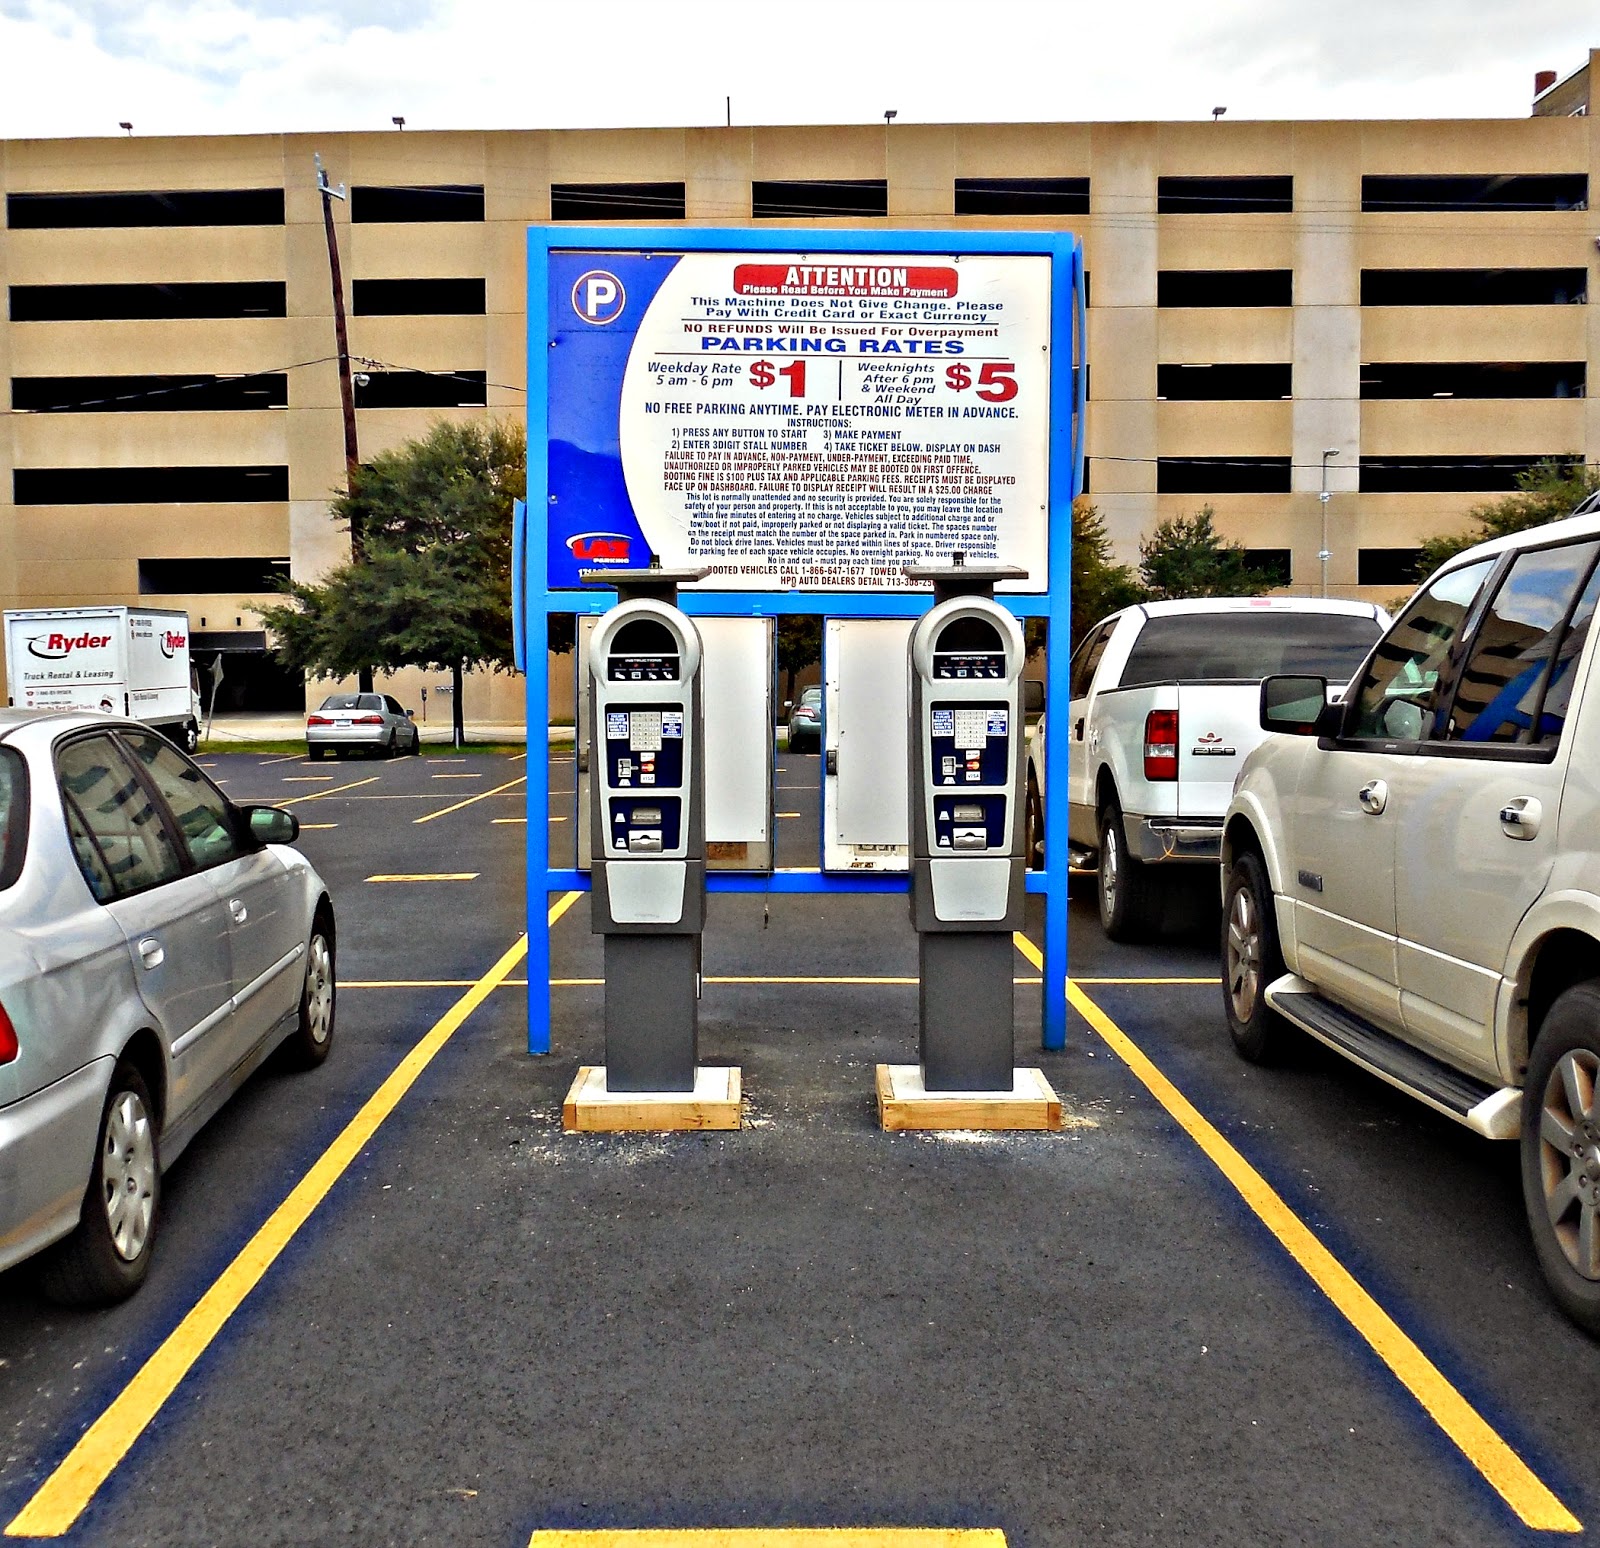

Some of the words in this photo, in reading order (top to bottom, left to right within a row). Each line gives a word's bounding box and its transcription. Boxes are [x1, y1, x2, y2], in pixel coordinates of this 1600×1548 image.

[786, 267, 907, 286] ATTENTION
[587, 278, 616, 317] P
[743, 284, 778, 294] Please
[781, 285, 808, 294] Read
[810, 285, 845, 295] Before
[846, 286, 868, 295] You
[870, 286, 900, 295] Make
[901, 287, 948, 298] Payment
[691, 297, 720, 307] This
[725, 297, 785, 308] Machine
[791, 298, 824, 308] Does
[830, 299, 853, 308] Not
[859, 299, 888, 309] Give
[894, 300, 950, 312] Change.
[957, 301, 1003, 310] Please
[706, 308, 731, 319] Pay
[737, 308, 769, 317] With
[774, 309, 817, 318] Credit
[822, 309, 855, 318] Card
[880, 310, 917, 319] Exact
[923, 311, 987, 322] Currency
[684, 324, 703, 333] NO
[708, 324, 773, 334] REFUNDS
[778, 325, 804, 334] Will
[809, 325, 827, 334] Be
[832, 326, 876, 335] Issued
[881, 326, 903, 335] For
[908, 326, 998, 338] Overpayment
[701, 337, 846, 352] PARKING
[859, 339, 964, 353] RATES
[648, 362, 708, 376] Weekday
[712, 363, 742, 374] Rate
[858, 362, 935, 375] Weeknights
[657, 375, 664, 385] 5
[668, 377, 688, 385] am
[701, 376, 708, 386] 6
[712, 378, 733, 388] pm
[749, 359, 806, 398] $1
[864, 374, 898, 384] After
[902, 375, 909, 384] 6
[914, 377, 934, 386] pm
[945, 362, 1019, 402] $5
[861, 384, 870, 393] &
[876, 384, 936, 394] Weekend
[874, 395, 893, 403] All
[896, 395, 922, 406] Day
[645, 402, 661, 414] NO
[664, 403, 692, 414] FREE
[696, 403, 746, 415] PARKING
[750, 404, 802, 416] ANYTIME.
[806, 404, 828, 416] PAY
[832, 405, 901, 417] ELECTRONIC
[906, 406, 944, 417] METER
[948, 406, 959, 418] IN
[963, 407, 1018, 418] ADVANCE.
[788, 419, 852, 428] INSTRUCTIONS:
[672, 428, 680, 438] 1)
[682, 428, 710, 437] PRESS
[712, 428, 729, 437] ANY
[732, 429, 765, 438] BUTTON
[768, 429, 779, 438] TO
[781, 429, 807, 438] START
[823, 430, 832, 440] 3)
[834, 430, 859, 439] MAKE
[861, 430, 901, 439] PAYMENT
[672, 440, 680, 450] 2)
[683, 440, 710, 449] ENTER
[713, 440, 740, 450] 3DIGIT
[743, 441, 768, 450] STALL
[771, 441, 808, 450] NUMBER
[824, 443, 833, 453] 4)
[835, 443, 856, 452] TAKE
[859, 443, 887, 452] TICKET
[891, 443, 923, 452] BELOW.
[926, 444, 961, 452] DISPLAY
[963, 444, 976, 452] ON
[978, 444, 1001, 453] DASH
[665, 451, 694, 460] FAILURE
[697, 451, 706, 460] TO
[708, 452, 721, 460] PAY
[724, 452, 731, 460] IN
[734, 452, 768, 462] ADVANCE,
[770, 452, 825, 462] NON-PAYMENT,
[827, 453, 890, 463] UNDER-PAYMENT,
[892, 454, 932, 463] EXCEEDING
[934, 455, 951, 463] PAID
[953, 455, 973, 464] TIME,
[664, 462, 720, 471] UNAUTHORIZED
[722, 462, 732, 471] OR
[734, 462, 780, 472] IMPROPERLY
[782, 463, 812, 472] PARKED
[813, 463, 849, 472] VEHICLES
[850, 464, 867, 472] MAY
[869, 464, 878, 473] BE
[880, 464, 909, 473] BOOTED
[911, 465, 922, 473] ON
[923, 465, 944, 473] FIRST
[946, 465, 981, 474] OFFENCE.
[664, 482, 683, 491] FACE
[685, 482, 696, 491] UP
[697, 482, 708, 491] ON
[710, 483, 757, 492] DASHBOARD.
[759, 483, 789, 492] FAILURE
[792, 484, 801, 492] TO
[803, 484, 833, 493] DISPLAY
[835, 484, 866, 493] RECEIPT
[869, 485, 886, 493] WILL
[889, 485, 916, 494] RESULT
[918, 485, 926, 494] IN
[928, 486, 933, 494] A
[935, 486, 961, 495] $25.00
[963, 486, 993, 495] CHARGE
[573, 539, 630, 558] LAZ
[690, 538, 700, 546] Do
[701, 538, 713, 546] not
[714, 538, 733, 546] block
[735, 538, 752, 546] drive
[754, 539, 774, 547] lanes.
[776, 539, 806, 547] Vehicles
[807, 539, 824, 547] must
[825, 540, 834, 548] be
[836, 540, 860, 550] parked
[861, 540, 882, 548] within
[884, 540, 900, 548] lines
[902, 540, 909, 548] of
[911, 542, 933, 551] space.
[935, 541, 955, 549] Driver
[957, 541, 996, 551] responsible
[740, 566, 778, 575] VEHICLES
[780, 566, 798, 575] CALL
[802, 566, 865, 575] 1-866-647-1677
[870, 567, 897, 575] TOWED
[799, 576, 819, 585] AUTO
[821, 577, 856, 585] DEALERS
[858, 577, 883, 586] DETAIL
[48, 632, 112, 653] Ryder
[167, 630, 185, 652] Ryder
[48, 671, 73, 679] Rental
[84, 670, 114, 678] Leasing
